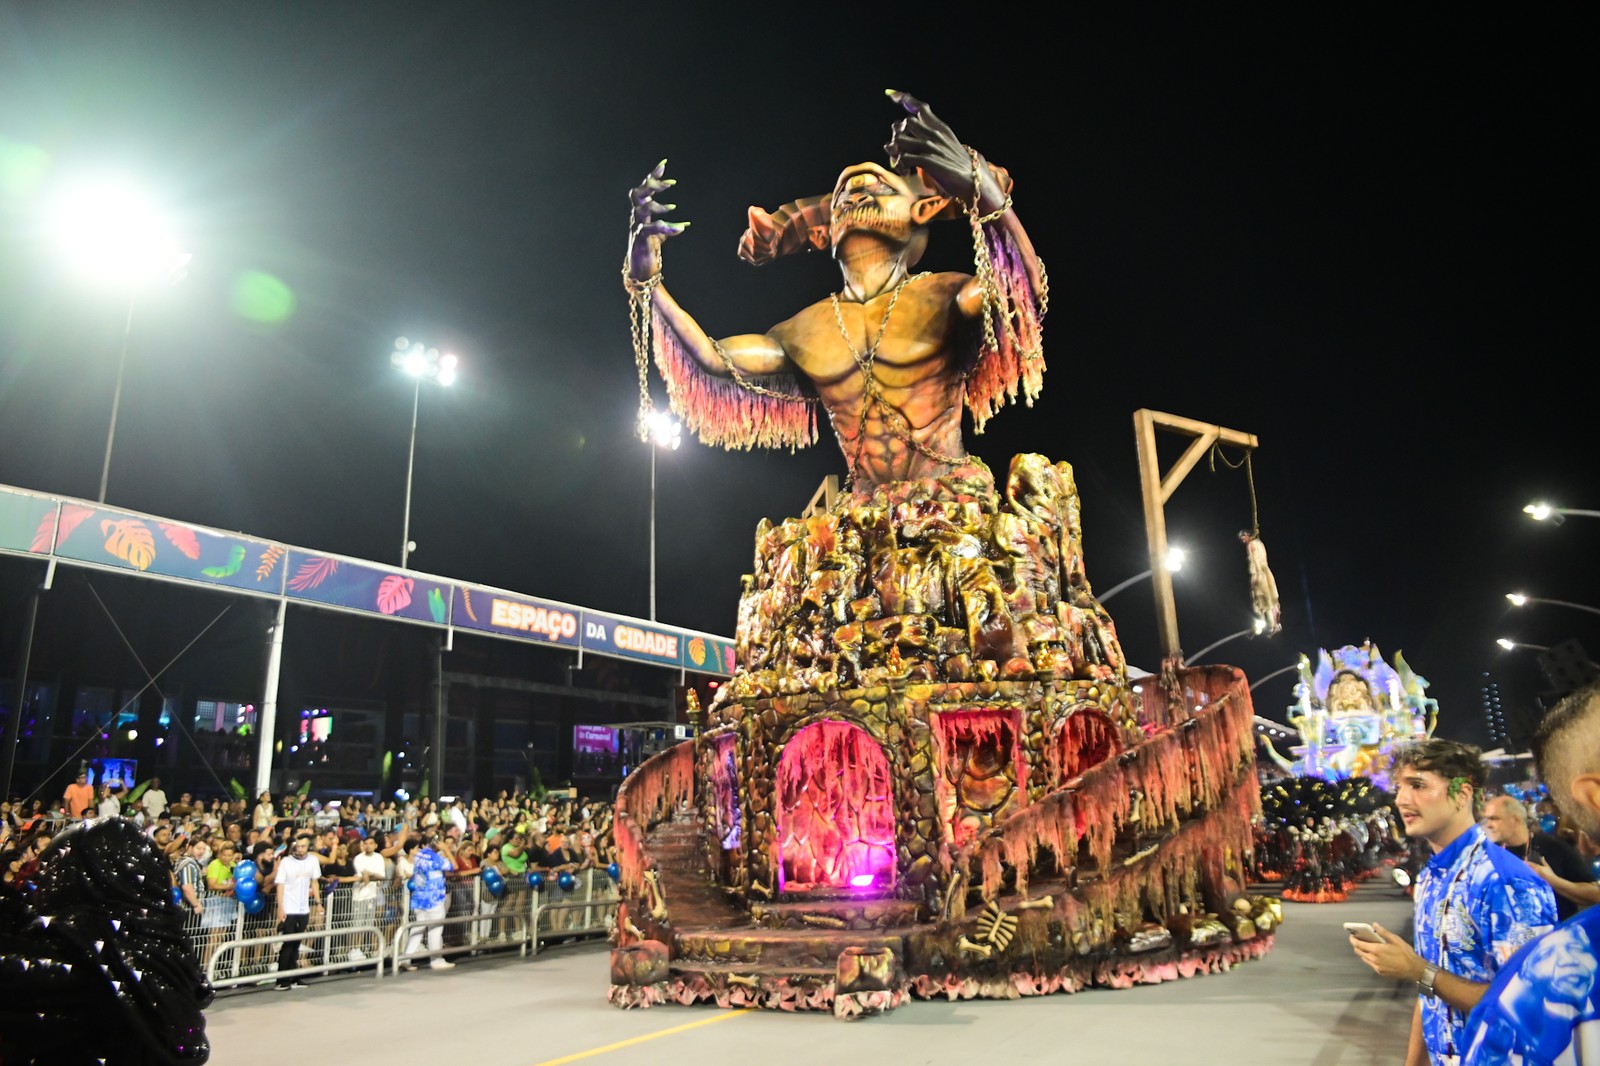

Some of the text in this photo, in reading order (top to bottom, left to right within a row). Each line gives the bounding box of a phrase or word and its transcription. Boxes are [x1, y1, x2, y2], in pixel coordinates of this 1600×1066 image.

[491, 598, 679, 659] ESPAÇO DA CIDADE
